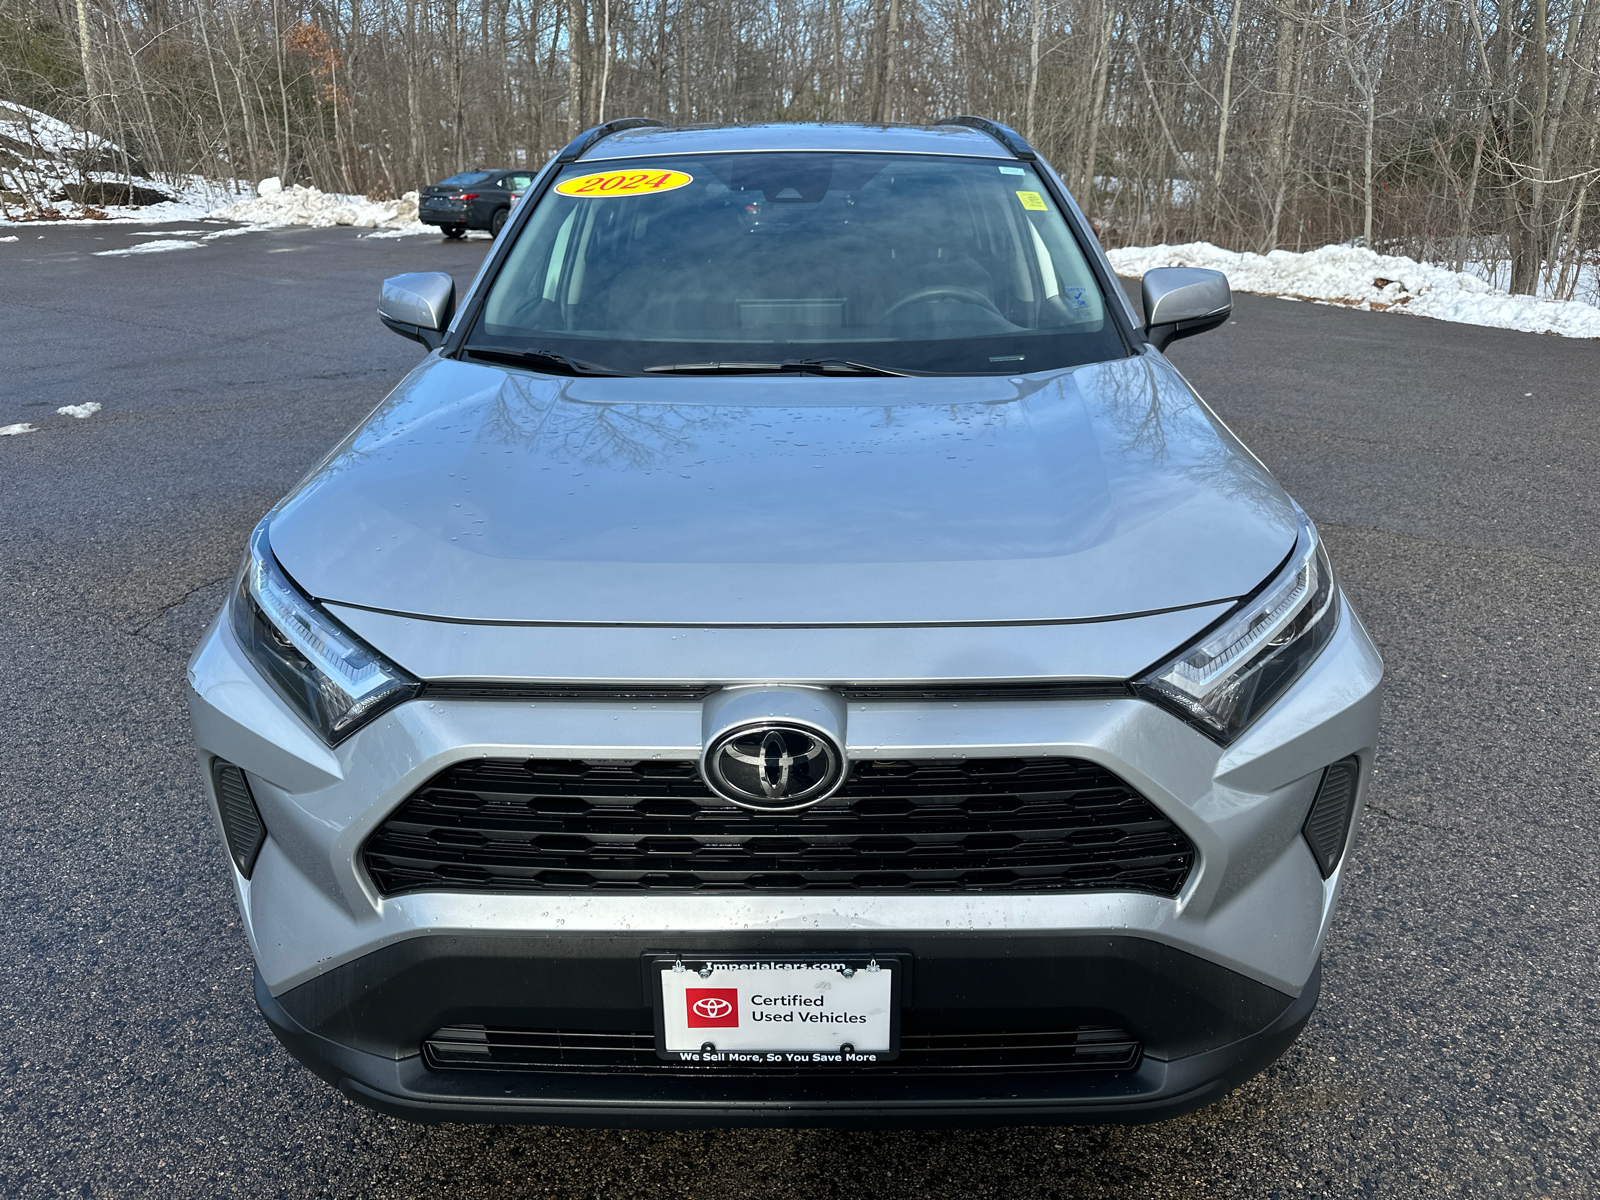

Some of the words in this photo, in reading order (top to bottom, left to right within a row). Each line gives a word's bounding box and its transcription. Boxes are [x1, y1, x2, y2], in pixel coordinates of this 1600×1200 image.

[574, 173, 671, 193] 2024
[706, 962, 846, 971] Imperialcars.com
[751, 995, 824, 1006] Certified
[752, 1011, 793, 1022] Used
[798, 1011, 867, 1023] Vehicles
[680, 1052, 699, 1061] We
[703, 1052, 724, 1061] Sell
[729, 1053, 763, 1062] More,
[767, 1053, 782, 1062] So
[786, 1053, 808, 1062] You
[812, 1053, 841, 1062] Save
[846, 1053, 876, 1062] More
